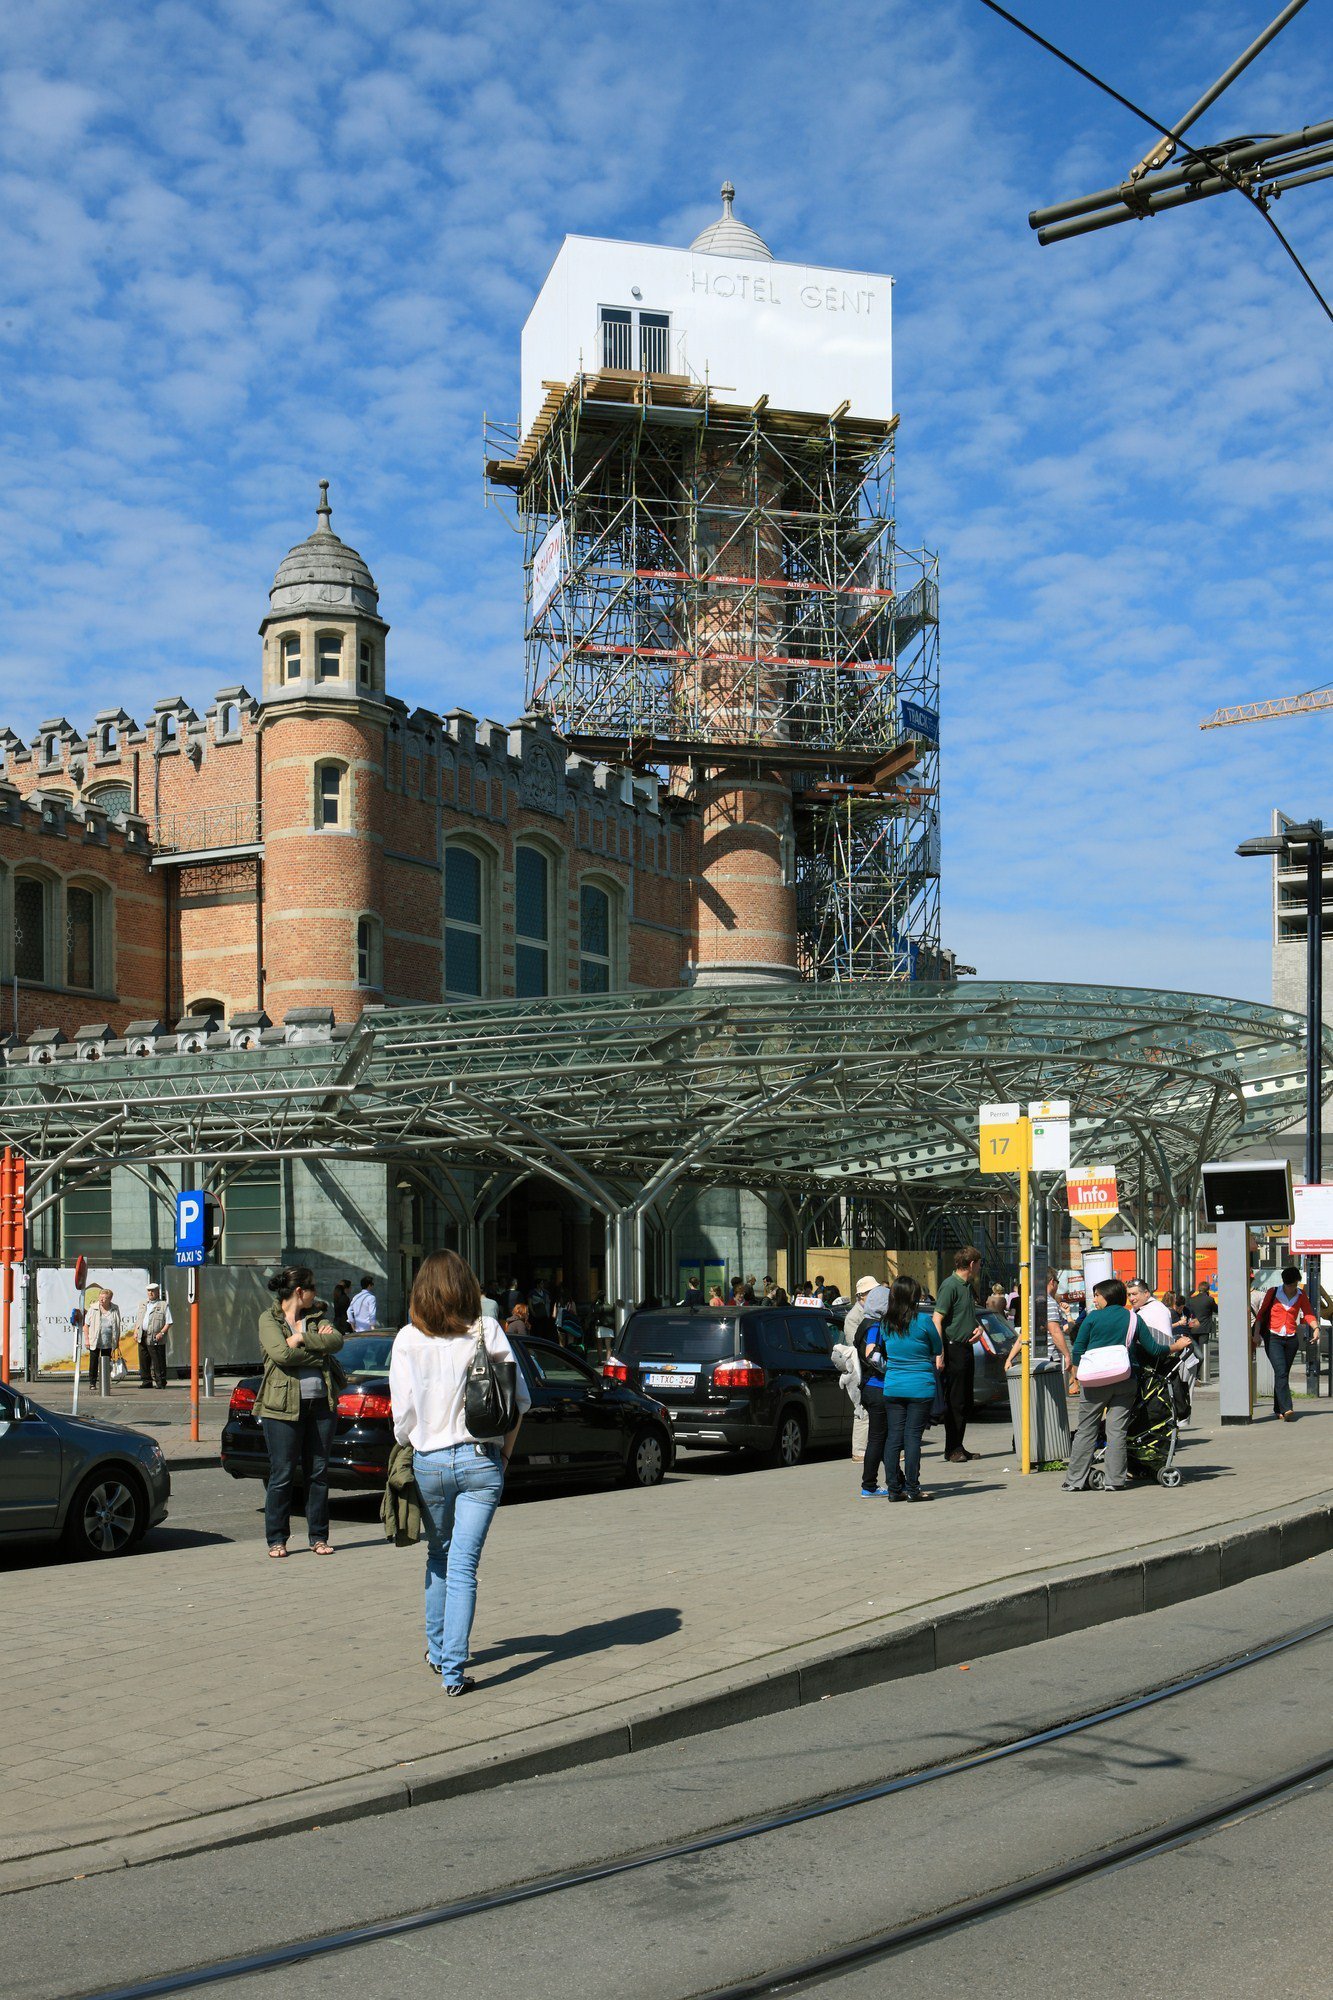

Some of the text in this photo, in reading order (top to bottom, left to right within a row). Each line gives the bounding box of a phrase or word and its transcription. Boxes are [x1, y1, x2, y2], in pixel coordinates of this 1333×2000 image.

[691, 271, 876, 314] HOTEL GENT
[989, 1138, 1010, 1155] 17
[1077, 1185, 1108, 1203] Info
[180, 1200, 199, 1239] P
[797, 1298, 819, 1306] TAXI
